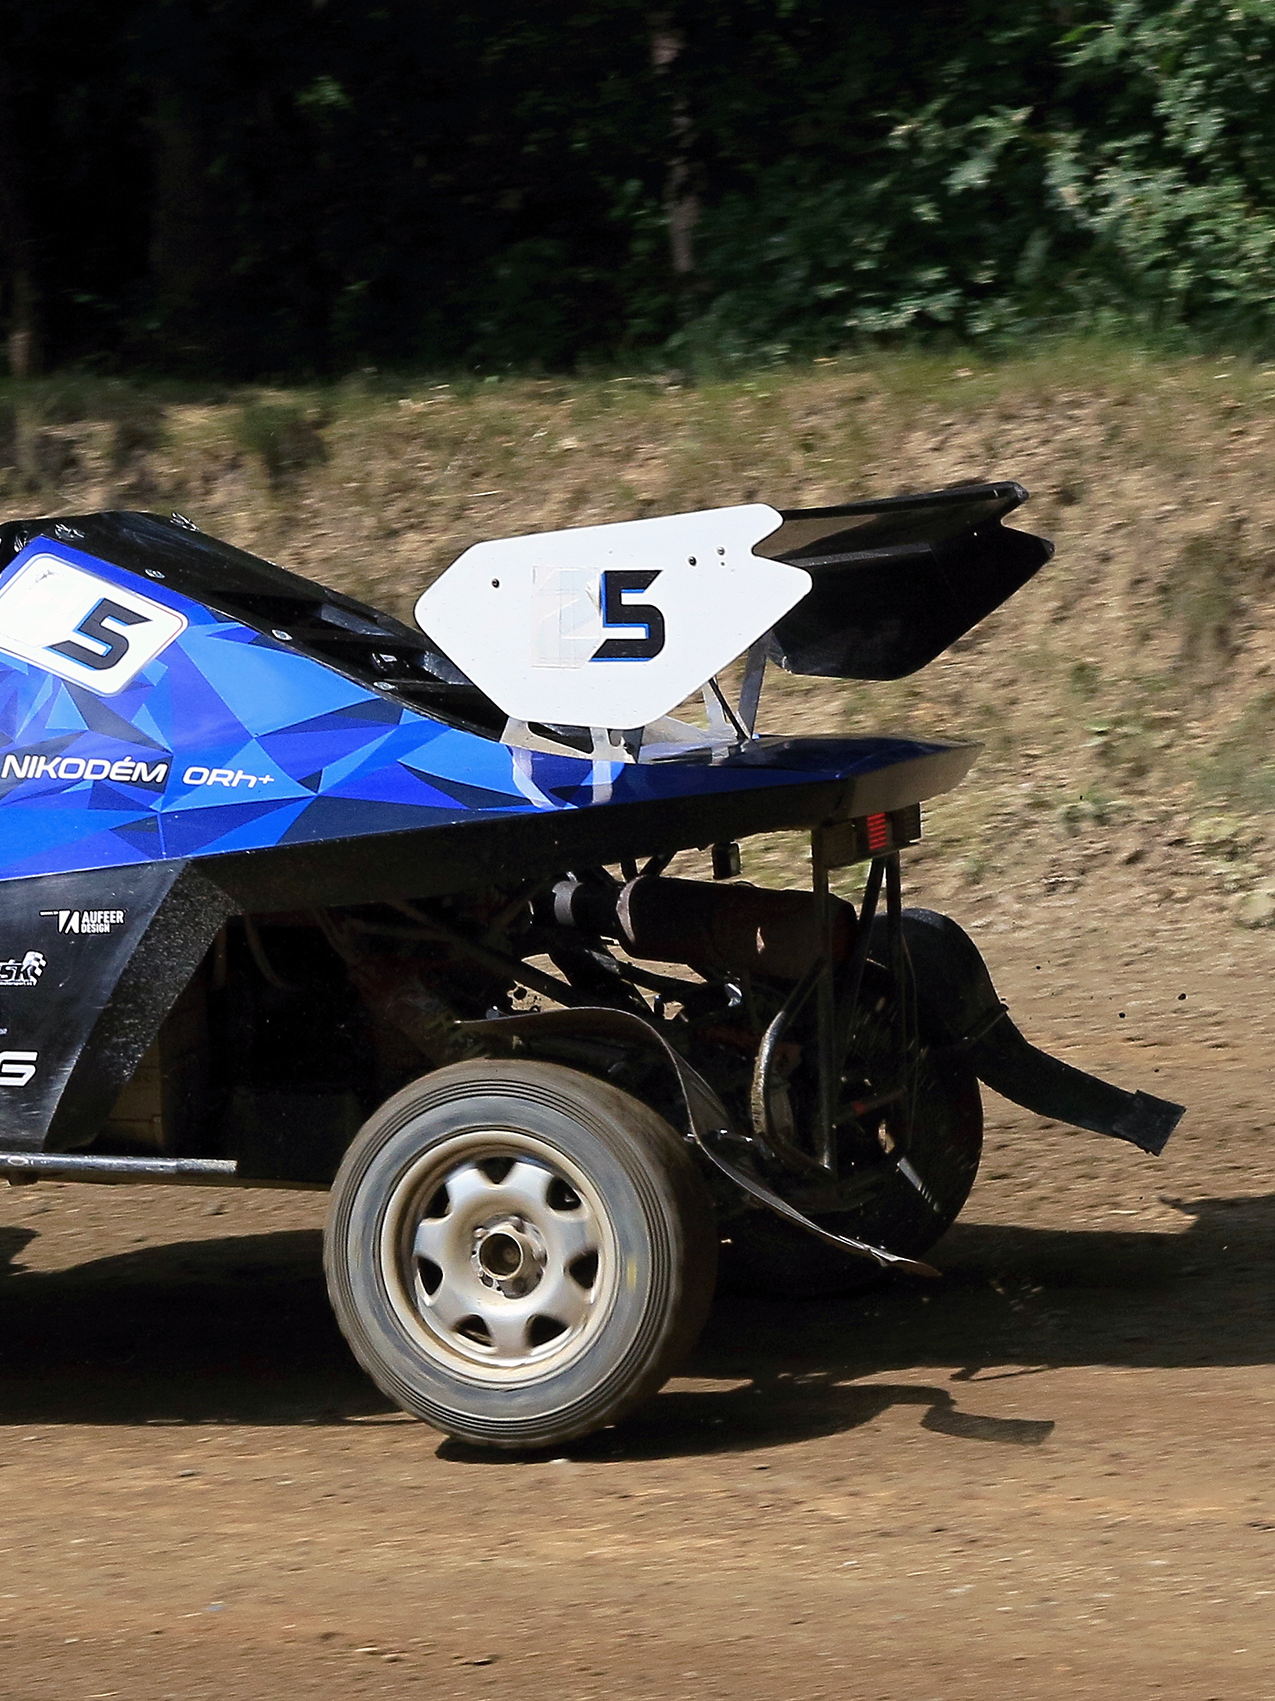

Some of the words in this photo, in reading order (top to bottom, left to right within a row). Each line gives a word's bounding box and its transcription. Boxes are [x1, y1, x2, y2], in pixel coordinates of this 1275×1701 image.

[587, 569, 666, 662] 5
[44, 597, 154, 671] 5
[0, 754, 169, 783] NIKODÉM
[80, 923, 111, 934] DESIGN
[81, 910, 124, 924] AUFEER
